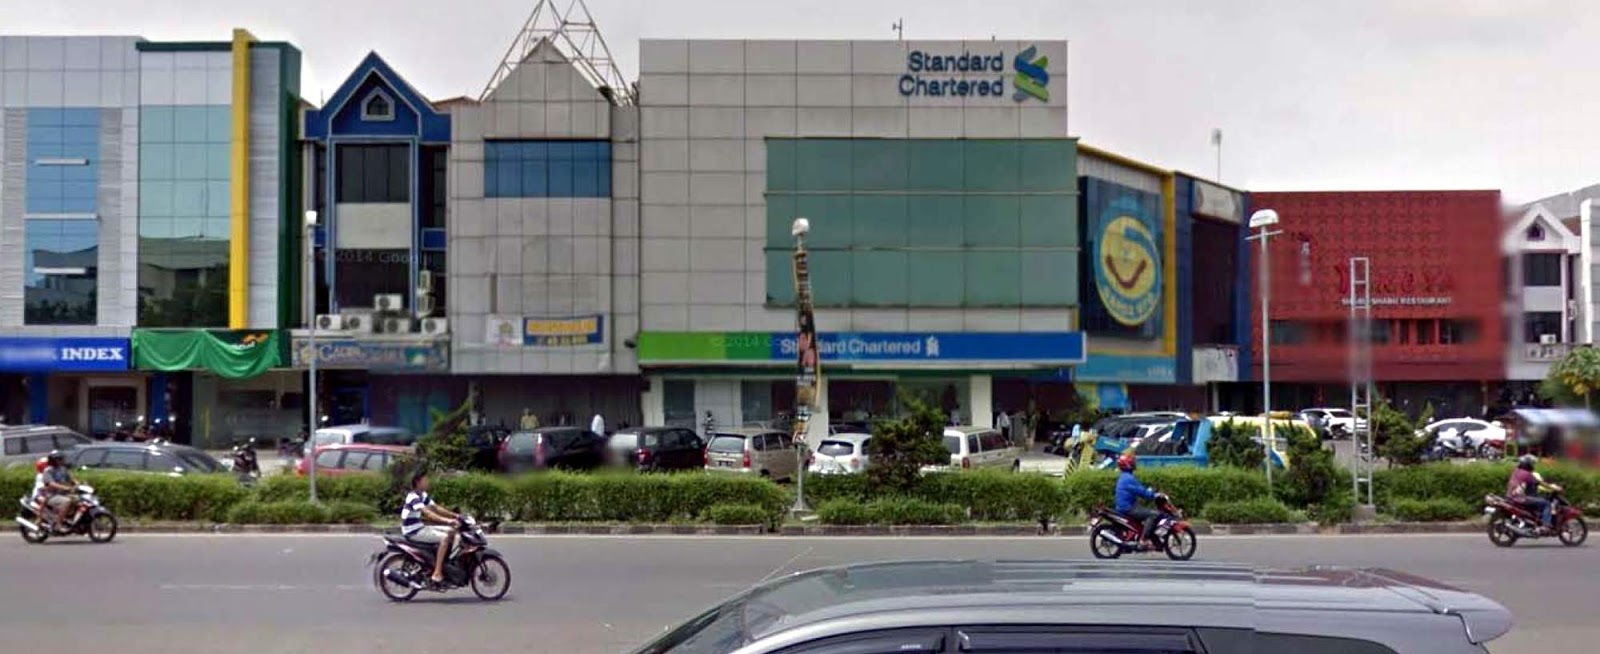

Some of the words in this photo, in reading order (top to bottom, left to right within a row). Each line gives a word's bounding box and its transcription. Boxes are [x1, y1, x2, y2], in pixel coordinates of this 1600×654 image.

[908, 50, 1003, 72] Standard
[899, 74, 1003, 96] Chartered
[62, 347, 124, 361] INDEX
[781, 338, 846, 354] Stdard
[848, 338, 920, 354] Chartered
